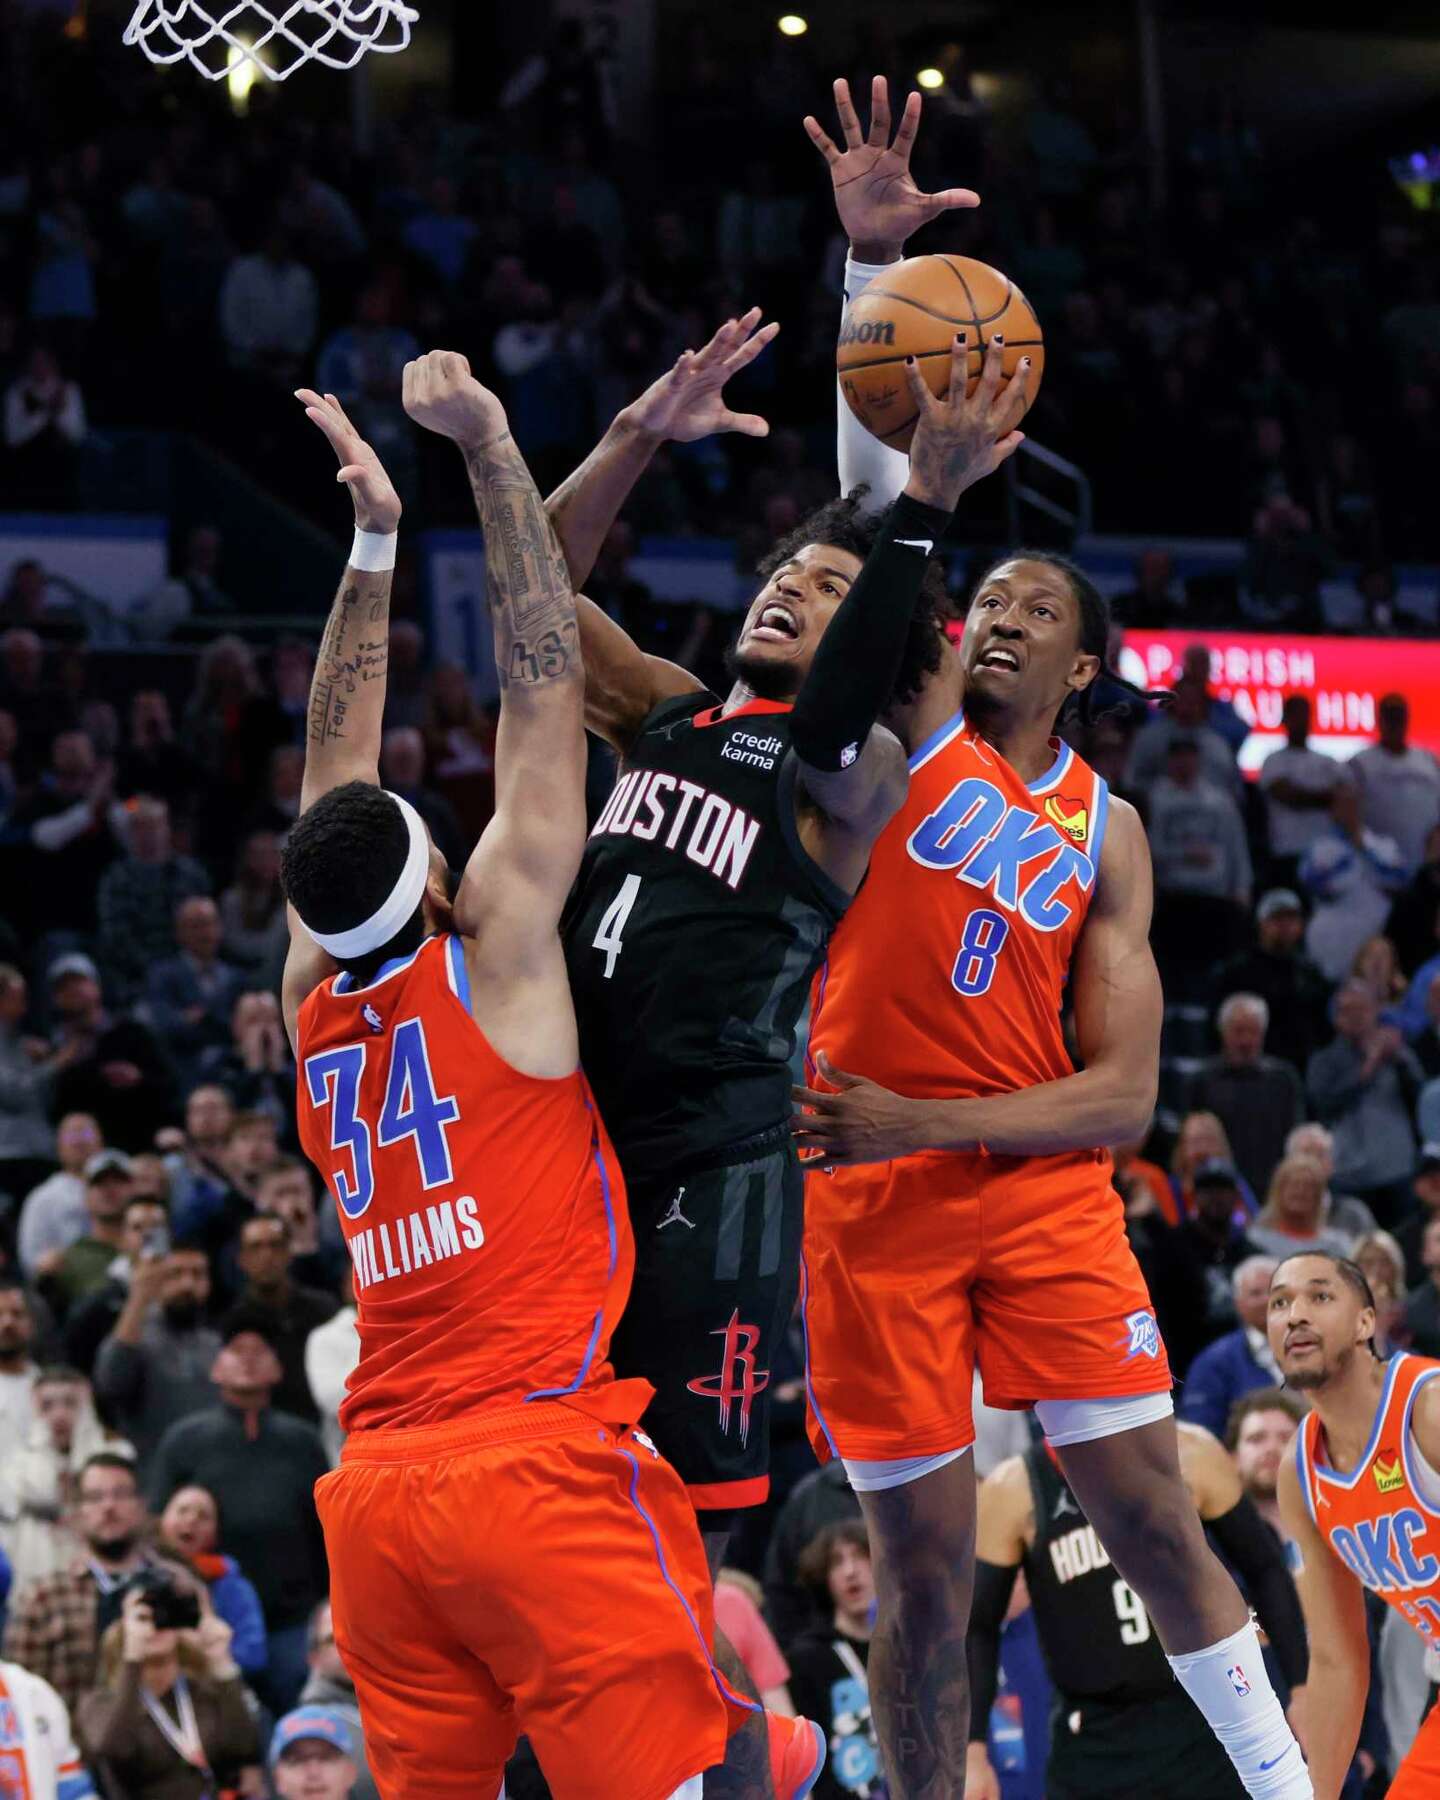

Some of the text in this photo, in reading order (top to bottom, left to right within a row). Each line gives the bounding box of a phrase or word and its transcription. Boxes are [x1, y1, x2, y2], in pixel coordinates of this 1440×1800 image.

[838, 313, 896, 347] lson
[1147, 644, 1315, 688] PRRISH
[720, 741, 775, 771] karma
[731, 731, 783, 755] credit
[588, 770, 761, 889] OUSTON
[906, 777, 1095, 933] OKC
[592, 873, 642, 979] 4
[951, 908, 1009, 997] 8
[304, 1016, 461, 1220] 34
[1049, 1525, 1111, 1585] HOU
[1330, 1508, 1440, 1592] OKC
[1112, 1579, 1151, 1645] 9
